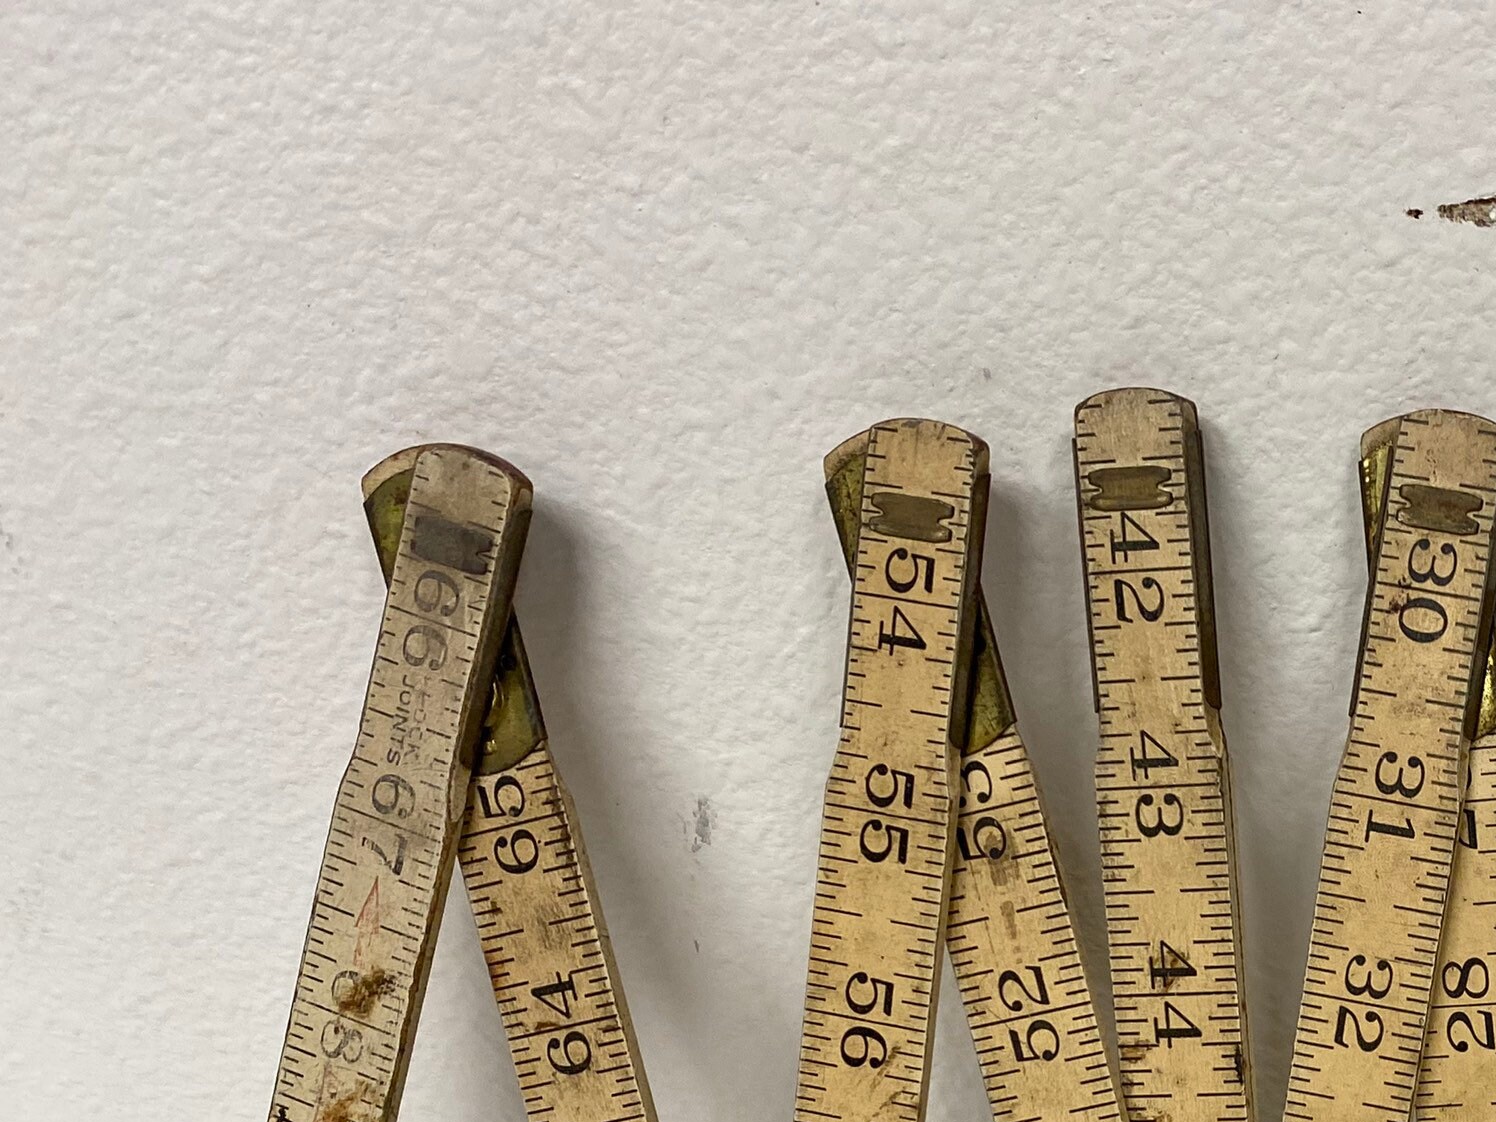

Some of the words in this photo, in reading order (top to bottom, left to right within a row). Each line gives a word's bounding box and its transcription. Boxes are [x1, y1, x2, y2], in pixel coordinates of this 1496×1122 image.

[877, 547, 935, 656] 54
[1109, 511, 1165, 623] 42
[1399, 538, 1458, 644] 30
[402, 570, 460, 671] 66
[386, 674, 416, 766] JOINTS
[362, 774, 416, 875] 67
[477, 775, 540, 874] 65
[859, 763, 915, 864] 55
[1129, 730, 1185, 838] 43
[1364, 751, 1426, 843] 31
[530, 971, 592, 1075] 64
[840, 971, 894, 1069] 56
[998, 965, 1060, 1063] 52
[1149, 940, 1203, 1049] 44
[1333, 954, 1394, 1052] 32
[1442, 957, 1496, 1053] 28
